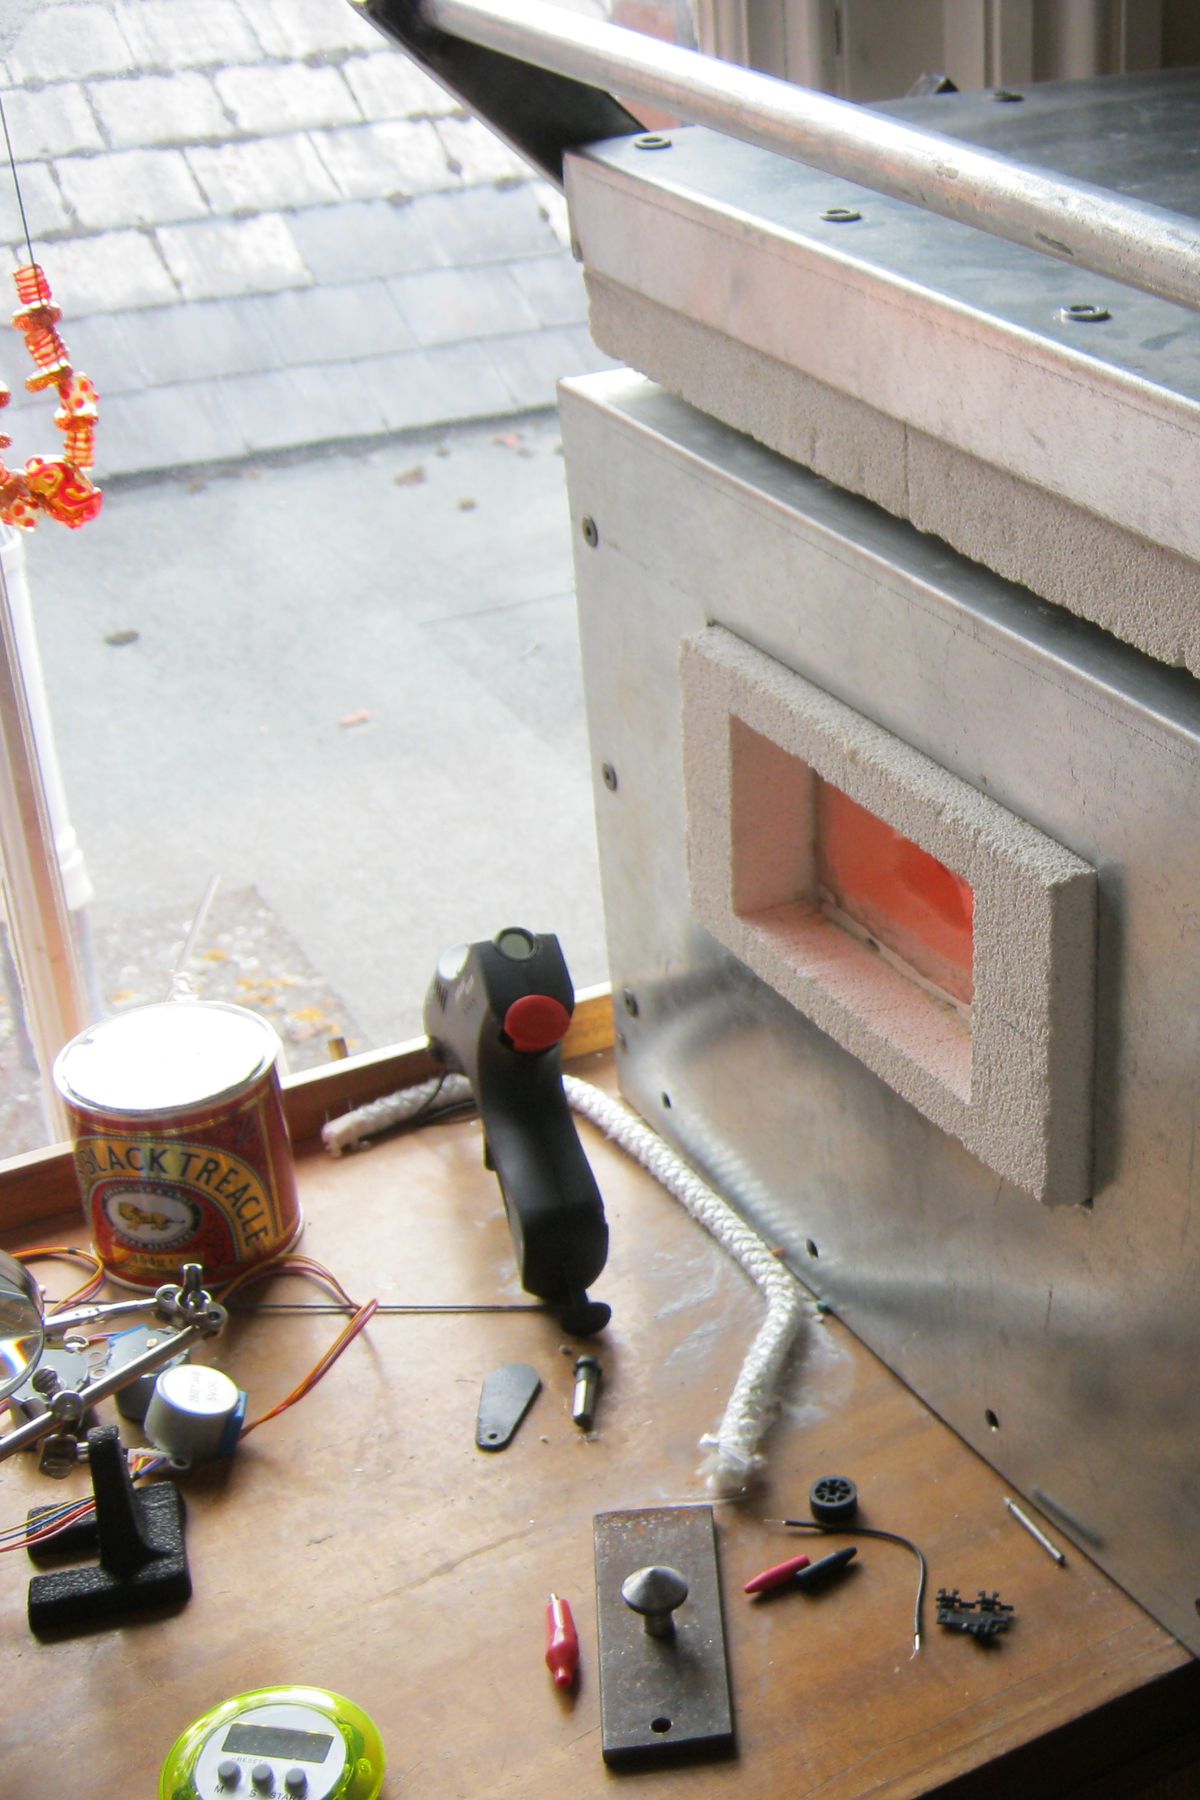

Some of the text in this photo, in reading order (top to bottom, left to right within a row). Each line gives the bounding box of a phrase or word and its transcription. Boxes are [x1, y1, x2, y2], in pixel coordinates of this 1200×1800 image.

[78, 1145, 269, 1248] BLACK TREACLE
[214, 1785, 225, 1794] M
[249, 1789, 257, 1798] S
